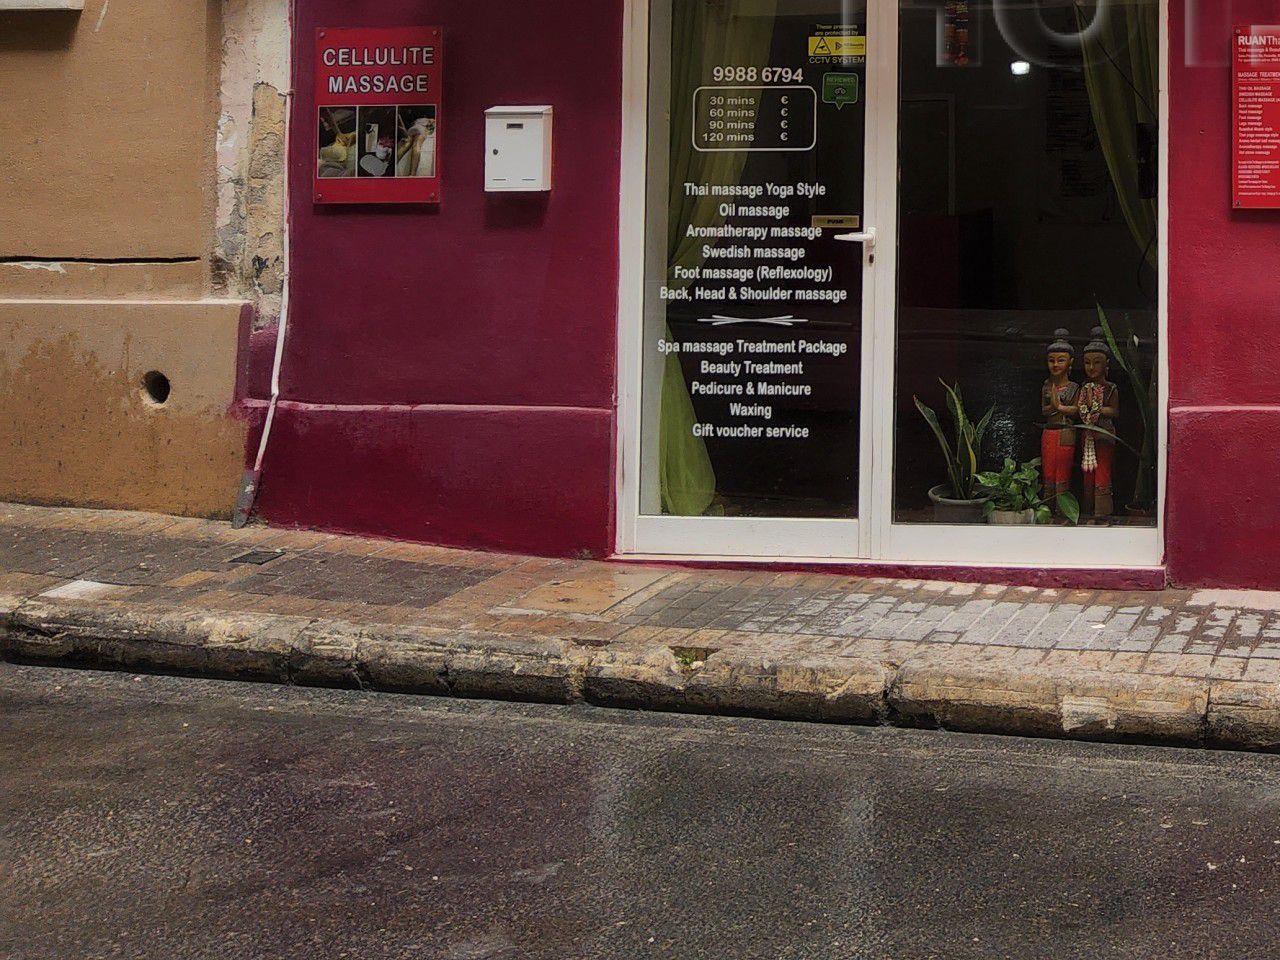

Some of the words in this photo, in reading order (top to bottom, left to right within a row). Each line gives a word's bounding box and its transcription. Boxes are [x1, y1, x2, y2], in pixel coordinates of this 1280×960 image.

[322, 47, 434, 66] CELLULITE
[809, 56, 831, 64] CCTV
[832, 56, 865, 64] SYSTEM
[713, 66, 757, 82] 9988
[761, 66, 804, 83] 6794
[328, 74, 429, 93] MASSAGE
[709, 96, 724, 105] 30
[727, 96, 755, 105] mins
[780, 95, 789, 105] €
[709, 108, 724, 117] 60
[727, 108, 755, 117] mins
[780, 108, 789, 117] €
[709, 120, 724, 130] 90
[726, 120, 755, 130] mins
[780, 120, 788, 129] €
[702, 132, 724, 142] 120
[726, 132, 755, 142] mins
[780, 132, 788, 141] €
[684, 183, 709, 196] Thai
[711, 185, 763, 199] massage
[766, 183, 794, 199] Yoga
[796, 183, 826, 199] Style
[719, 204, 735, 217] Oil
[738, 206, 790, 220] massage
[686, 224, 768, 241] Aromatherapy
[770, 227, 822, 241] massage
[702, 245, 751, 258] Swedish
[754, 247, 806, 261] massage
[674, 266, 700, 279] Foot
[702, 269, 754, 282] massage
[756, 266, 833, 282] (Reflexology)
[659, 287, 692, 302] Back,
[695, 287, 726, 300] Head
[728, 287, 737, 300] &
[740, 287, 793, 300] Shoulder
[795, 289, 847, 303] massage
[657, 339, 680, 354] Spa
[682, 341, 734, 355] massage
[736, 339, 796, 353] Treatment
[798, 340, 847, 356] Package
[701, 360, 741, 377] Beauty
[743, 360, 803, 374] Treatment
[691, 381, 743, 395] Pedicure
[746, 382, 755, 395] &
[757, 381, 812, 395] Manicure
[729, 402, 772, 419] Waxing
[692, 423, 714, 437] Gift
[716, 424, 763, 437] voucher
[766, 424, 809, 437] service
